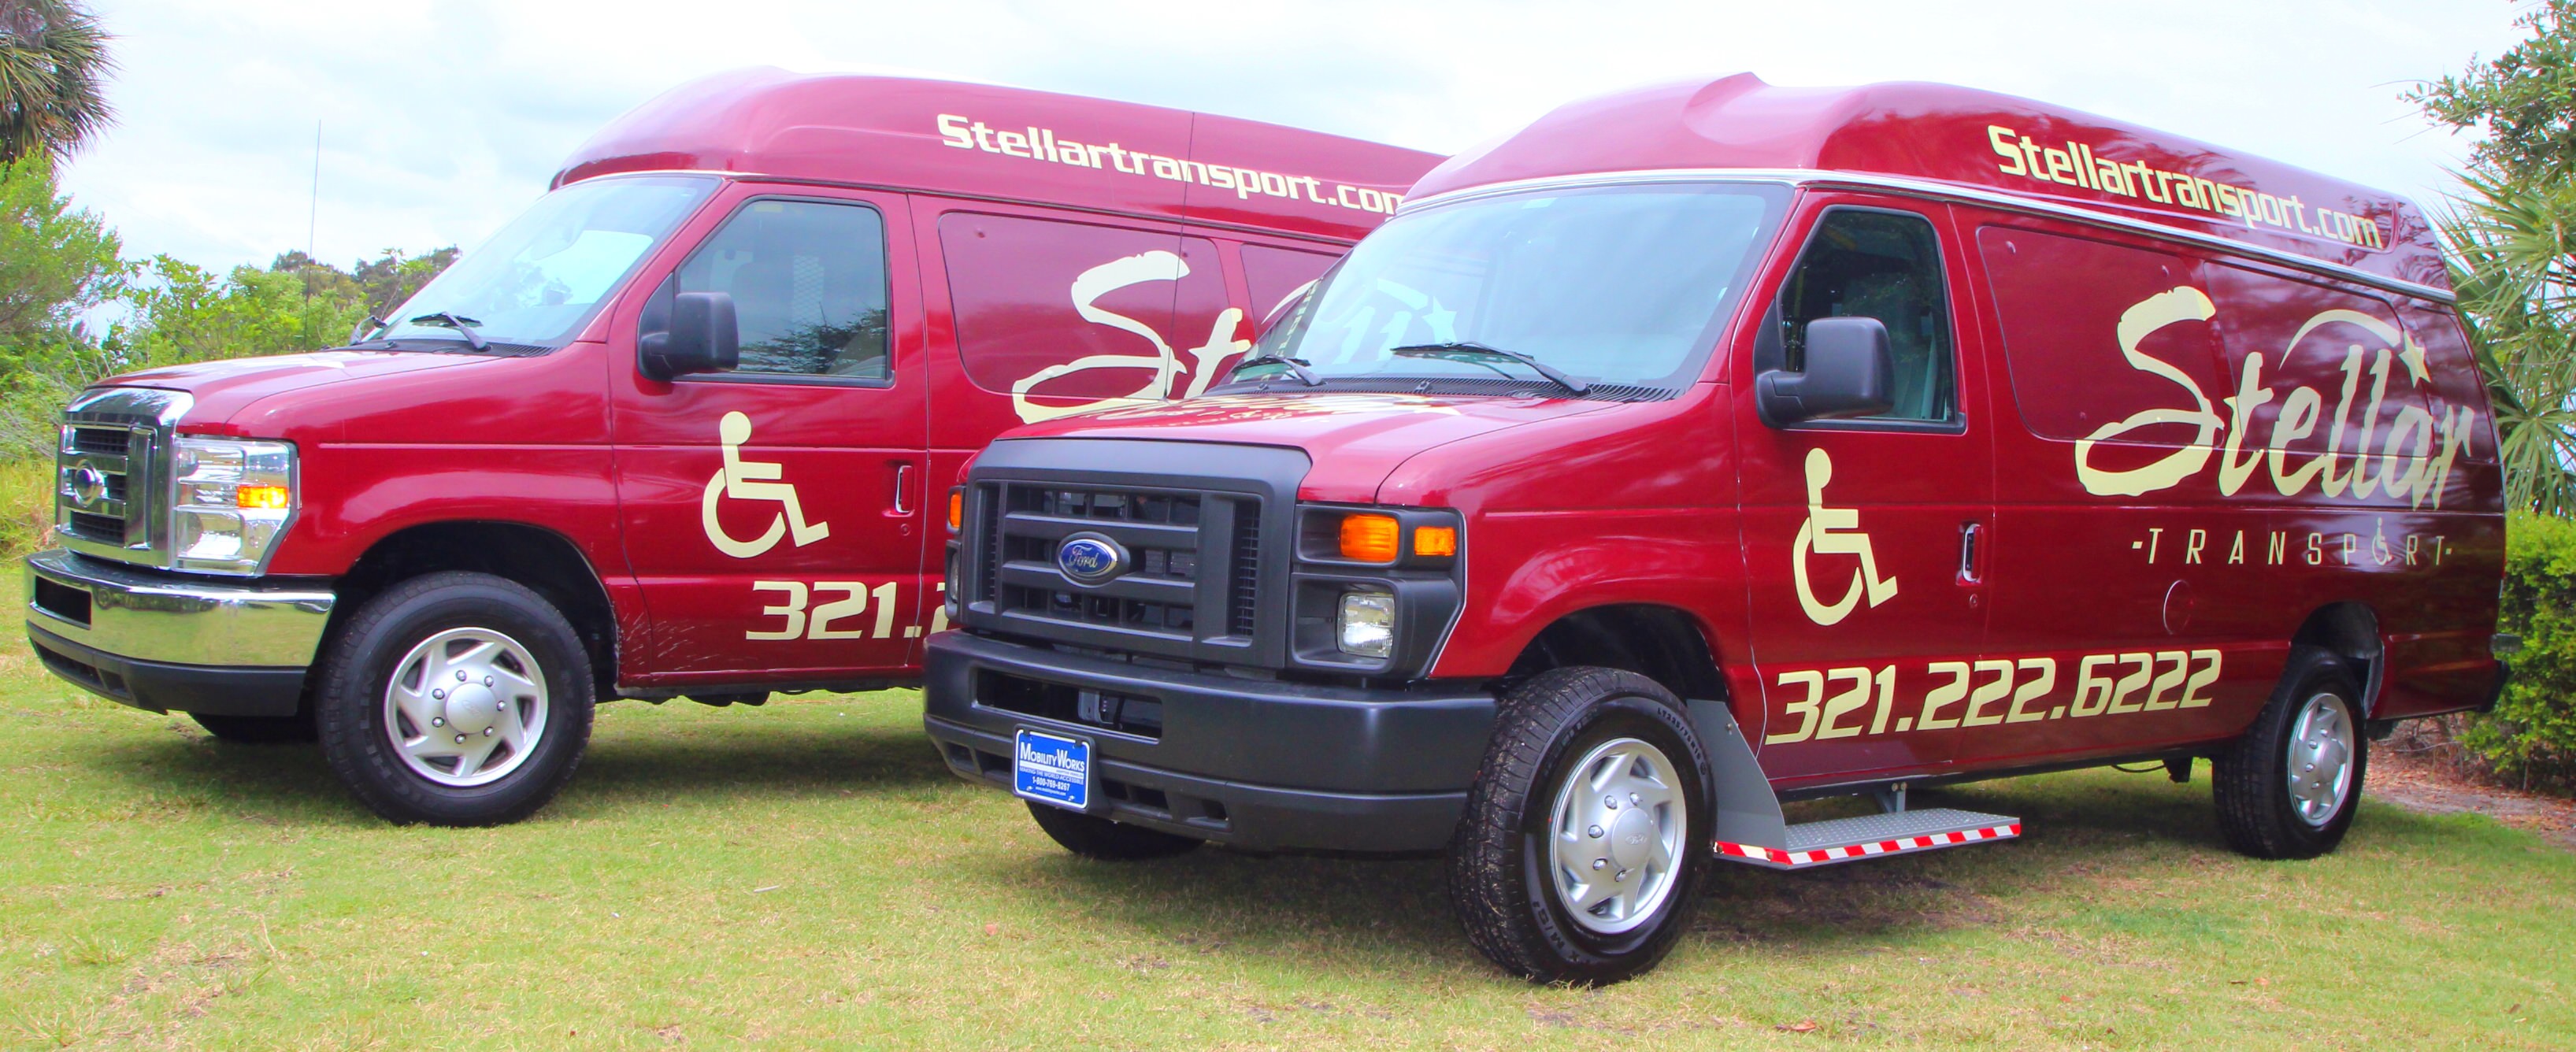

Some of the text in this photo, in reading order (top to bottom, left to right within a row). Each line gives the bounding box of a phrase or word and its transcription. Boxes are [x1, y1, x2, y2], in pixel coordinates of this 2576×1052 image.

[1988, 124, 2383, 249] Stellartransport.com
[2074, 285, 2474, 511] Stellar
[1067, 544, 1099, 569] Ford
[745, 580, 951, 641] 321.
[1766, 649, 2223, 745] 321.222.6222
